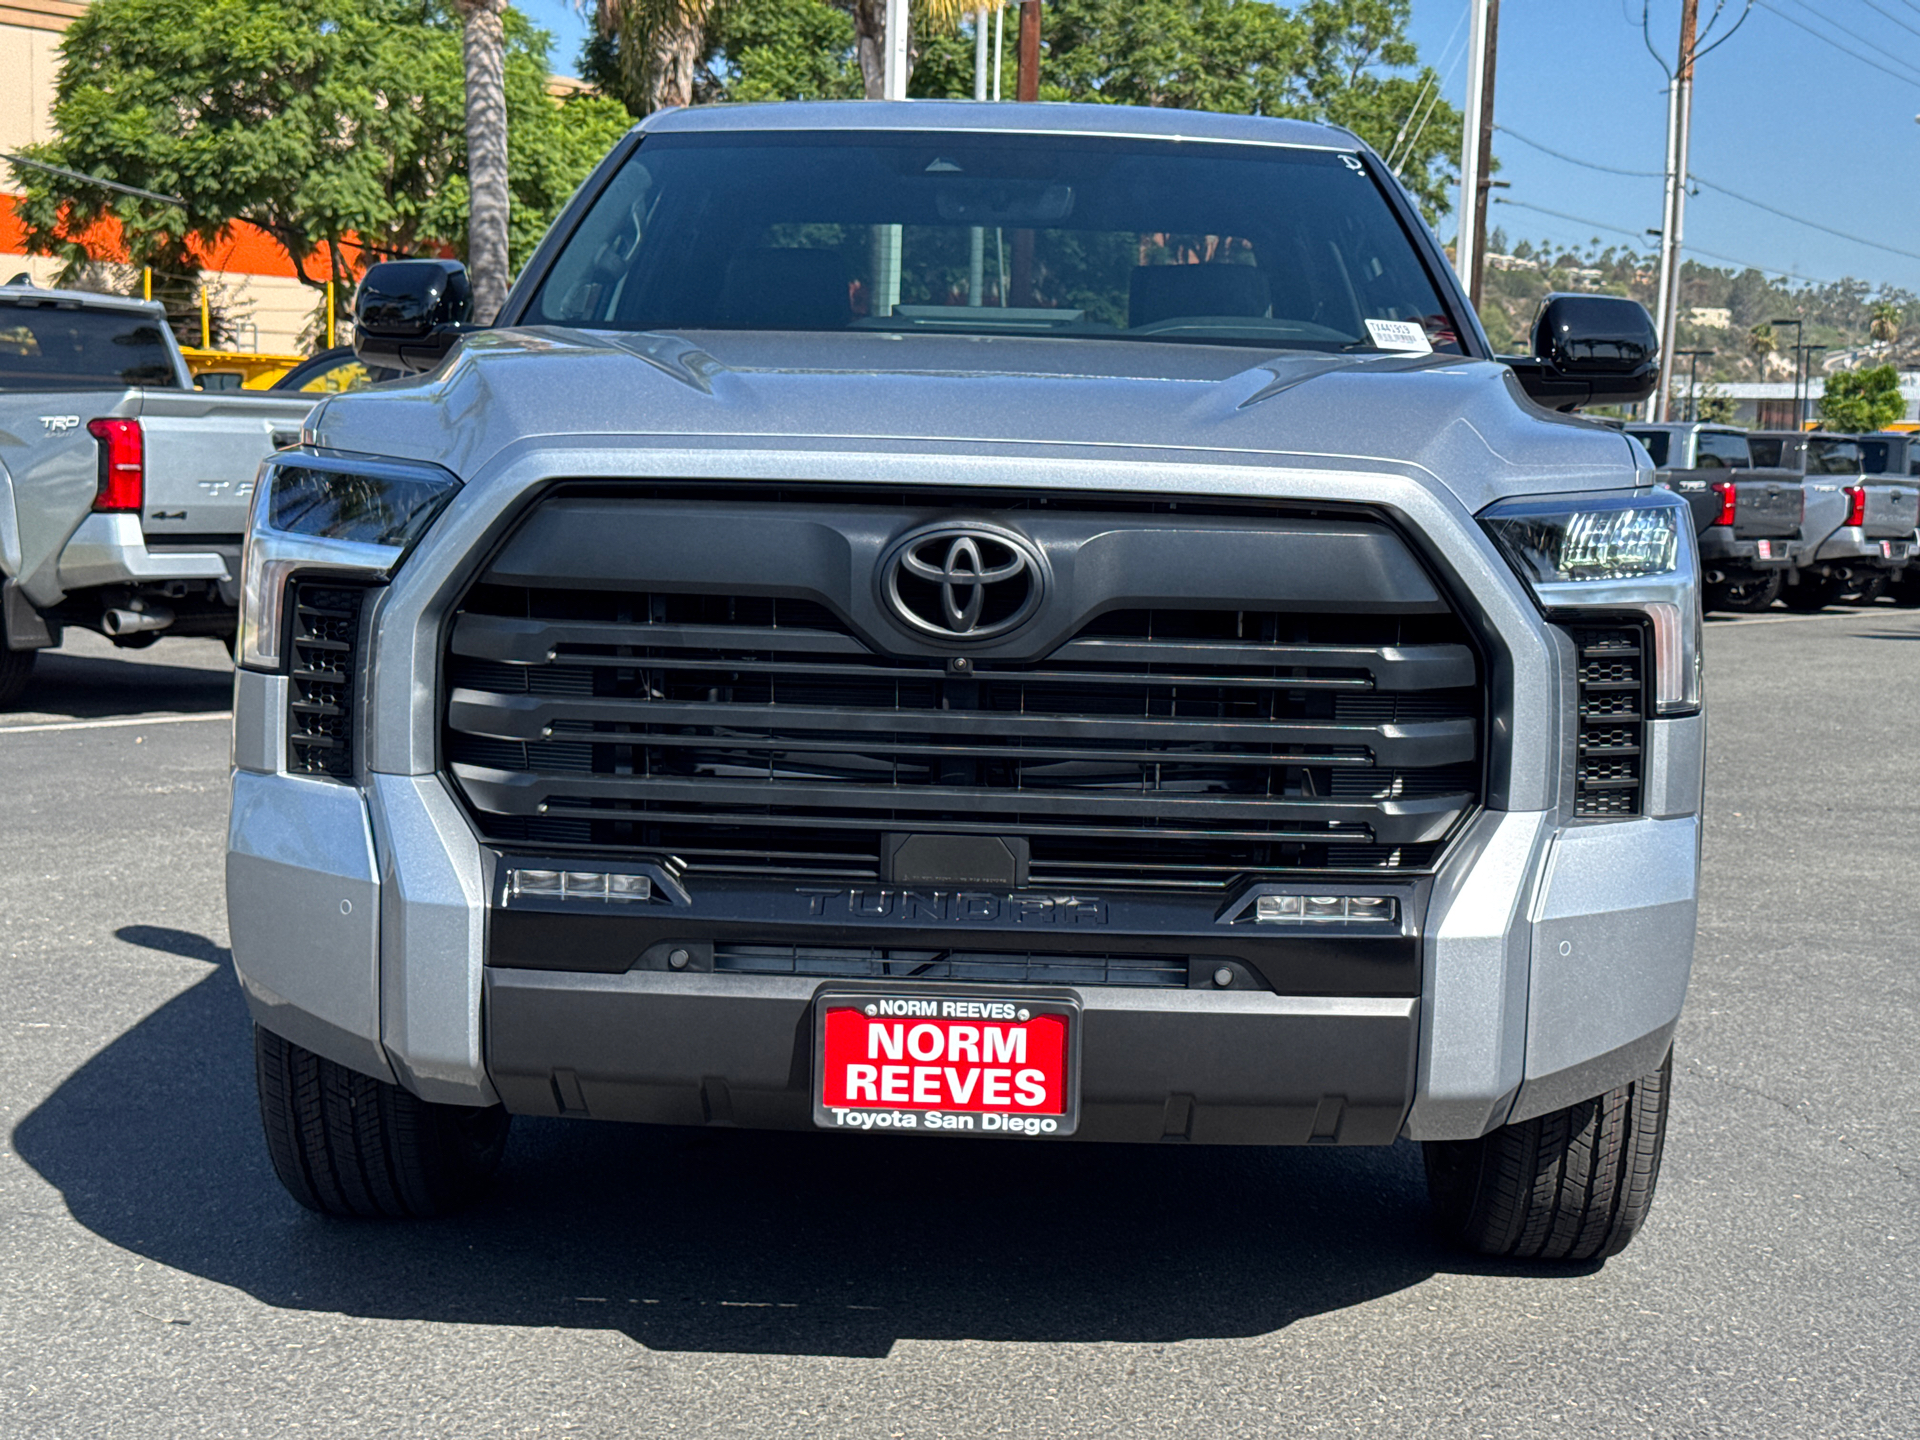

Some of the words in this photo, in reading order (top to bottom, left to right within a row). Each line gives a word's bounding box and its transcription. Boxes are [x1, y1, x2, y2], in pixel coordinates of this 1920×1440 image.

[39, 415, 80, 431] TRD
[1680, 481, 1706, 490] TRD
[795, 887, 1108, 924] TUNDRA
[879, 1000, 938, 1017] NORM
[942, 1002, 1016, 1019] REEVES
[867, 1023, 1027, 1063] NORM
[846, 1063, 1046, 1106] REEVES
[831, 1108, 918, 1129] Toyota
[923, 1111, 974, 1130] San
[981, 1113, 1058, 1136] Diego
